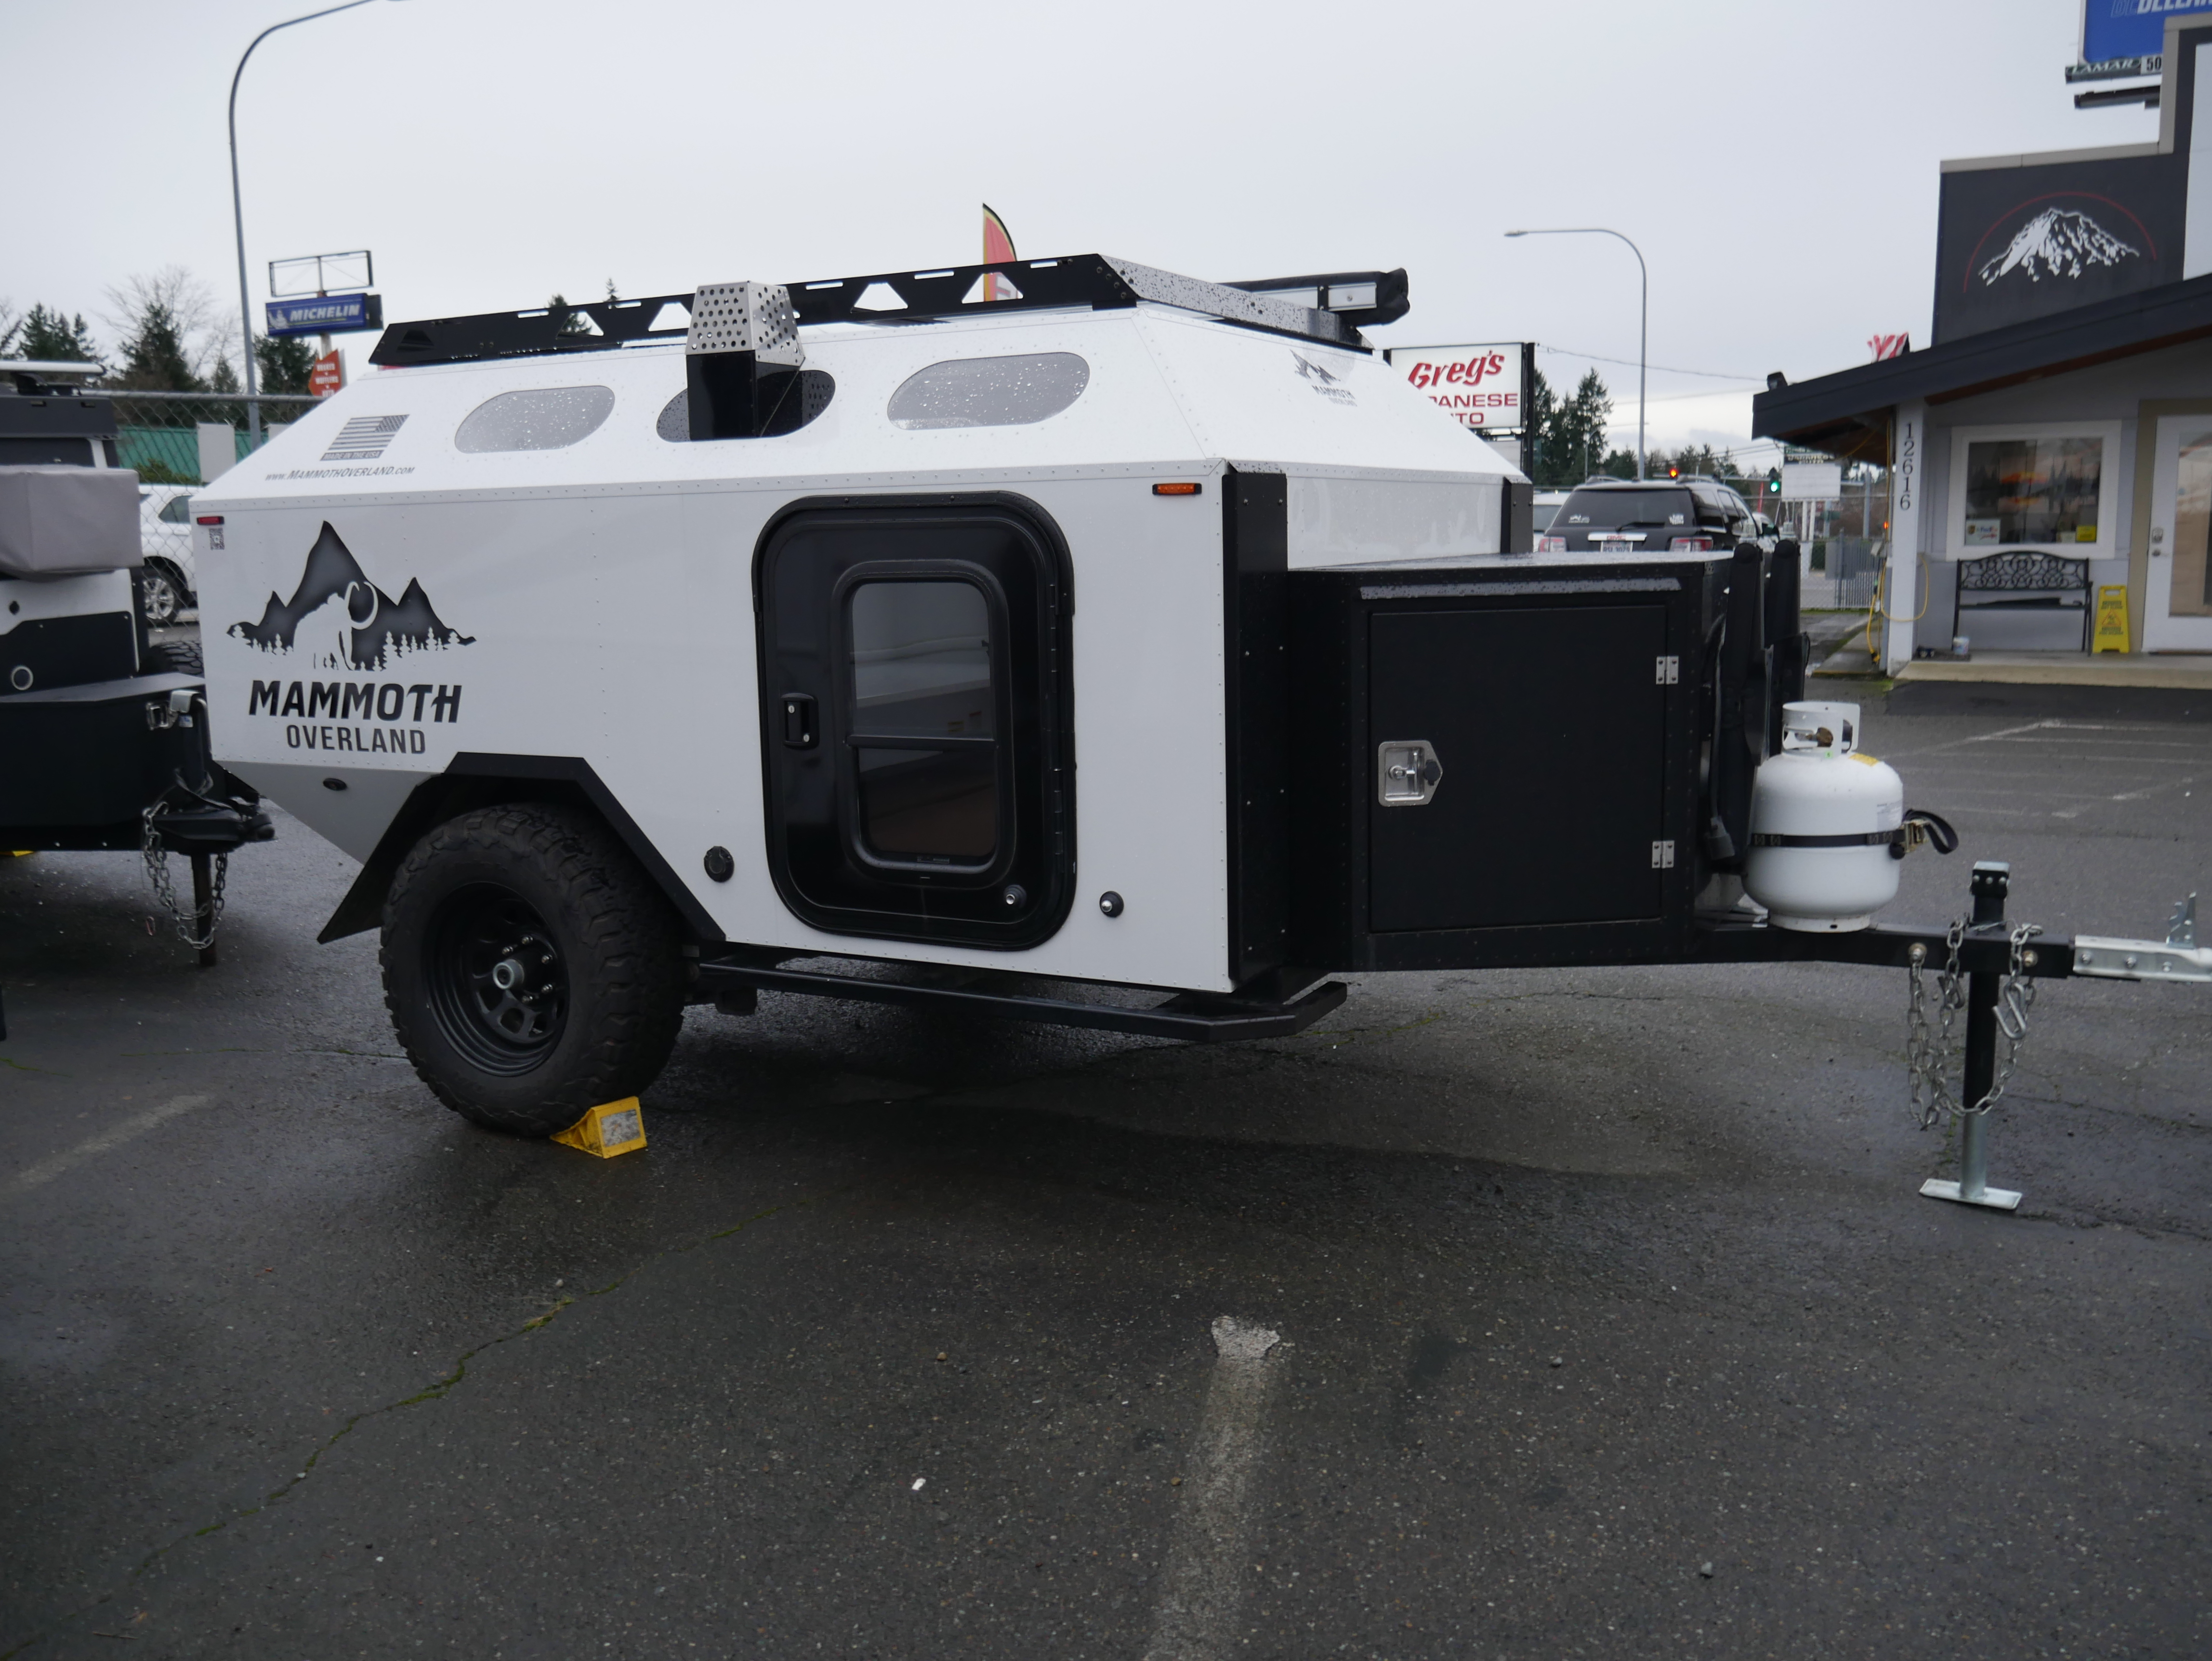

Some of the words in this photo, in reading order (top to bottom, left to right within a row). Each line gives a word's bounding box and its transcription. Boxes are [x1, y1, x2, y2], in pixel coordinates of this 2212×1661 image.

[290, 304, 360, 322] MICHELIN
[316, 363, 335, 371] BRAKES
[1408, 350, 1505, 390] Greg's
[316, 376, 339, 385] MUFFLERS
[1312, 385, 1356, 399] MAMMOTH
[1450, 412, 1485, 425] TO
[1900, 422, 1914, 511] 12616
[249, 680, 462, 723] MAMMOTH
[286, 724, 425, 754] OVERLAND
